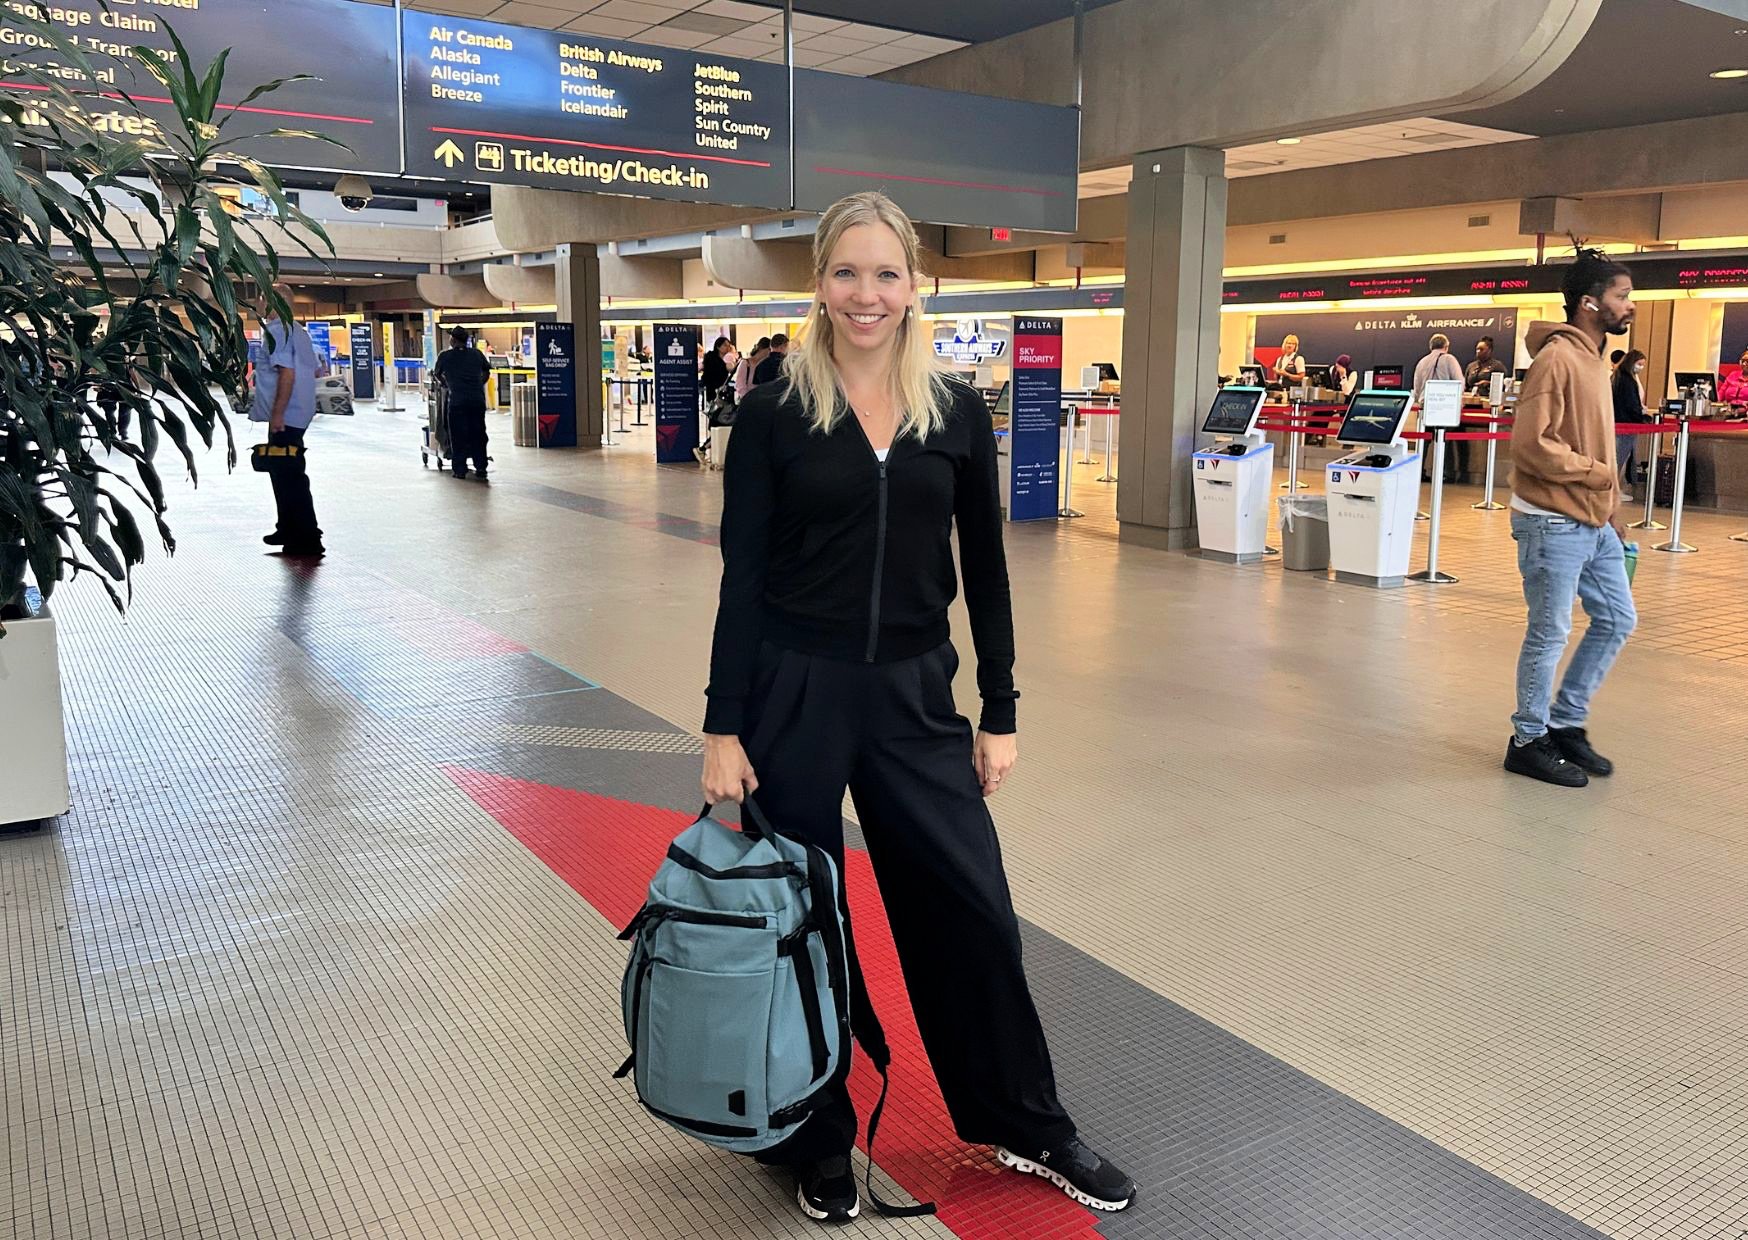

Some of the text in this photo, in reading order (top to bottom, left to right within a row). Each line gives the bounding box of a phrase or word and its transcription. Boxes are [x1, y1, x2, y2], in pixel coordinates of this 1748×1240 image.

[100, 11, 157, 33] Claim
[429, 26, 513, 51] Air Canada
[430, 46, 481, 65] Alaska
[559, 43, 663, 73] British Airways
[47, 61, 115, 84] Renal
[430, 64, 500, 87] Allegiant
[560, 62, 598, 80] Delta
[693, 62, 741, 83] JetBlue
[431, 84, 483, 103] Breeze
[560, 80, 616, 100] Frontier
[694, 81, 753, 101] Southern
[560, 99, 628, 119] Icelandair
[695, 98, 730, 117] Spirit
[695, 116, 771, 140] Sun Country
[695, 132, 738, 150] United
[511, 148, 710, 190] Ticketing/Check-in
[1027, 321, 1052, 329] DELTA
[1365, 320, 1396, 330] DELTA
[1400, 320, 1422, 329] KLM
[1426, 318, 1484, 329] AIRFRANCE
[1019, 347, 1035, 355] SKY
[1019, 355, 1054, 363] PRIORITY
